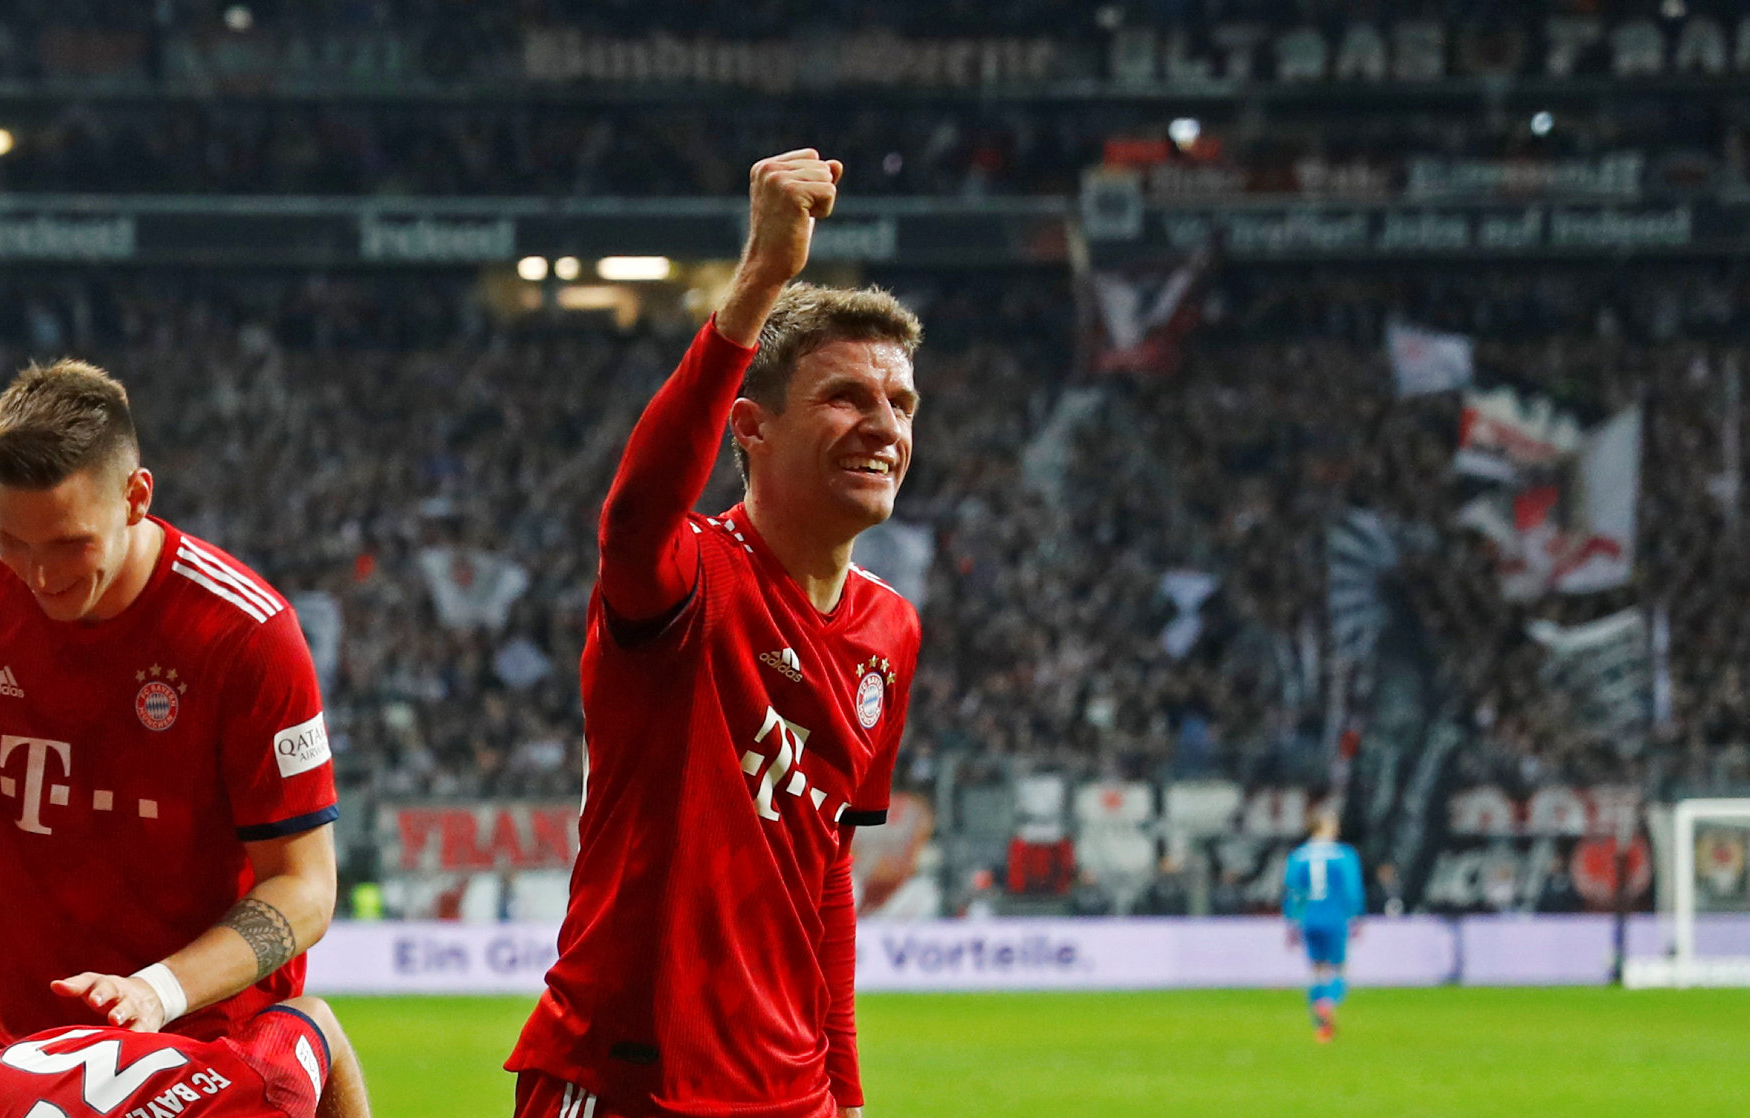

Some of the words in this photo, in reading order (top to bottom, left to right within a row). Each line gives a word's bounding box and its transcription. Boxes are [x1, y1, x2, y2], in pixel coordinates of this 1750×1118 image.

[759, 651, 802, 683] adidas
[393, 937, 470, 974] Ein
[882, 933, 1093, 975] Vorteile.
[191, 1067, 232, 1094] FC
